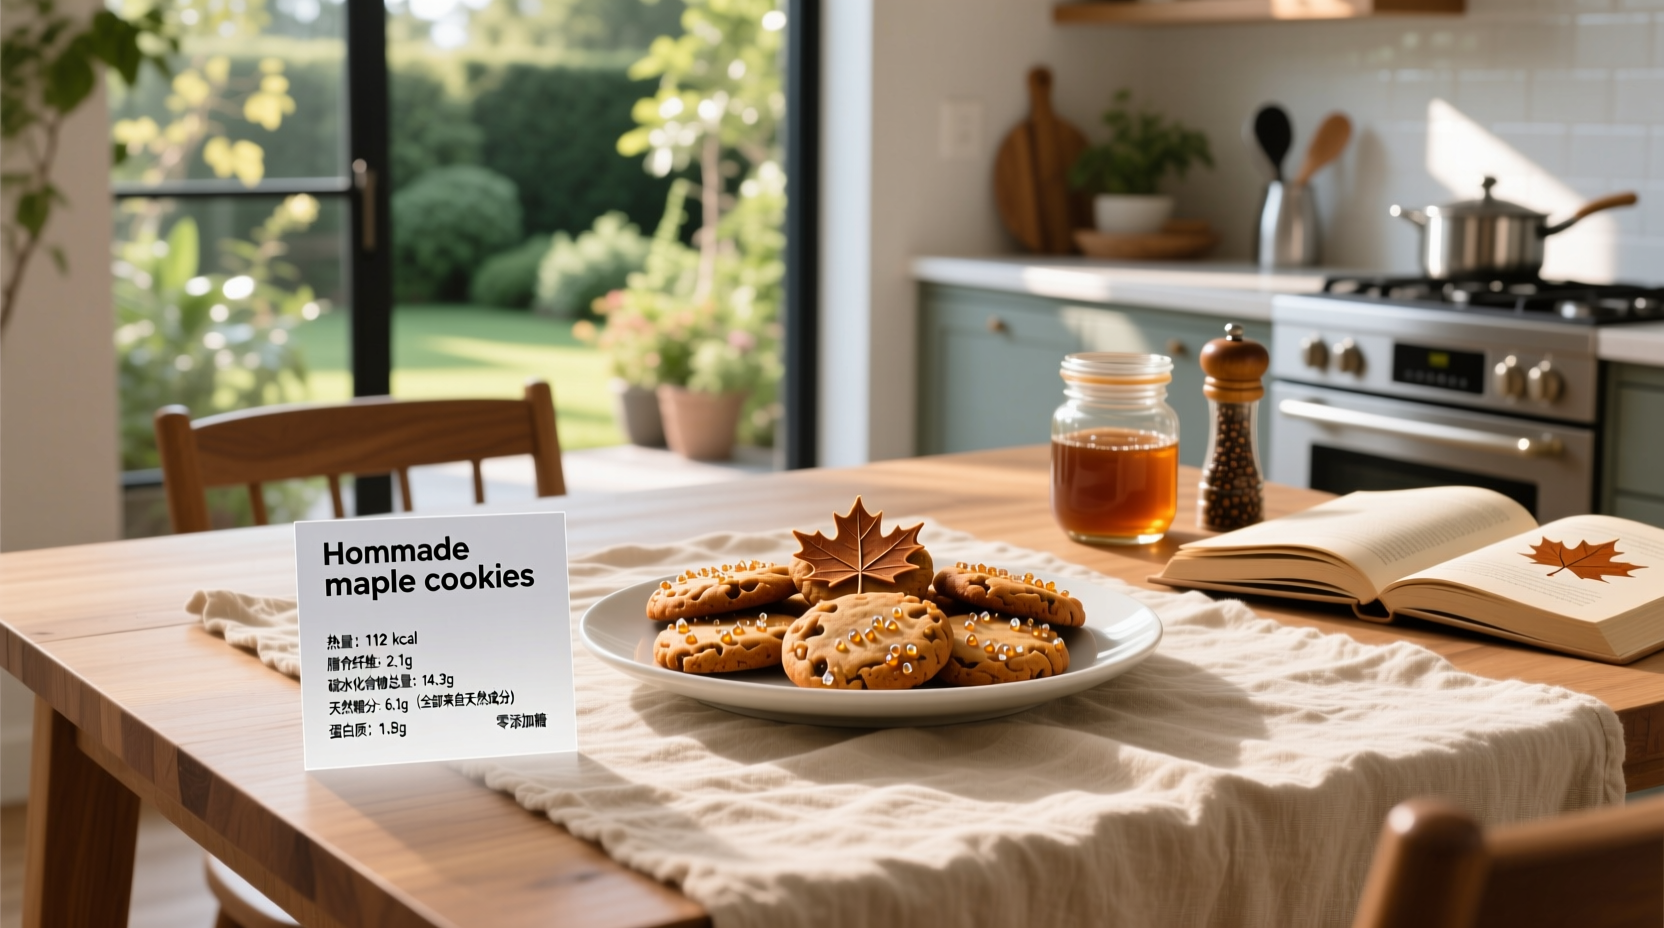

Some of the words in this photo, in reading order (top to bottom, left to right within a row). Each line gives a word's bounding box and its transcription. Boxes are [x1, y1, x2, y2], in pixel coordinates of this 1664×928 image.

[324, 536, 469, 565] Hommade
[326, 569, 416, 601] maple
[424, 563, 535, 592] cookies
[366, 633, 387, 646] 112
[393, 631, 417, 645] kcal
[387, 654, 412, 670] 2.1g
[422, 673, 454, 688] 14.3g
[385, 698, 408, 713] 6.1g
